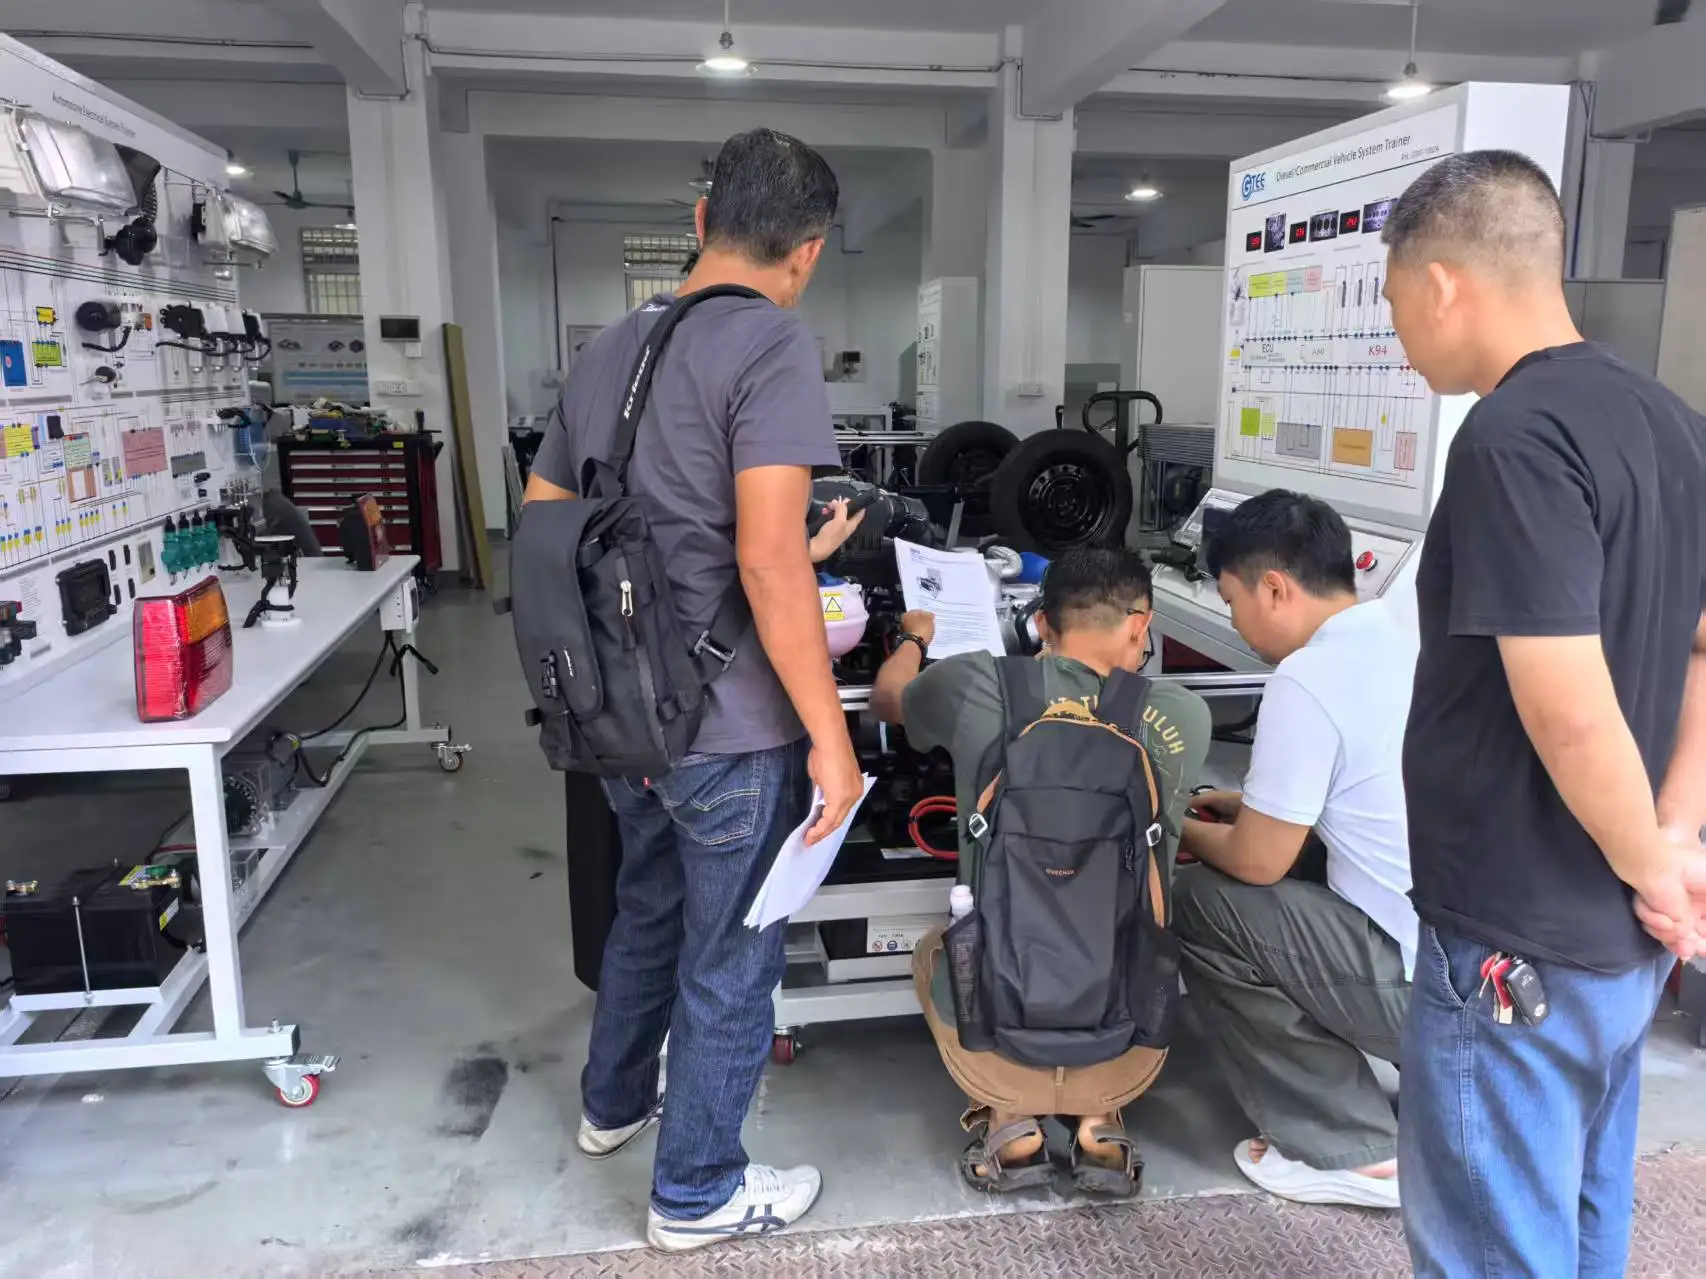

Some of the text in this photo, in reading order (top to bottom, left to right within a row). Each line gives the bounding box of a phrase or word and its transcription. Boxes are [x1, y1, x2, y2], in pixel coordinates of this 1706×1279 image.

[1333, 148, 1357, 166] Vehicle
[1358, 142, 1384, 161] System
[1384, 135, 1412, 152] Trainer
[1262, 343, 1274, 353] ECU
[1368, 344, 1388, 357] K94
